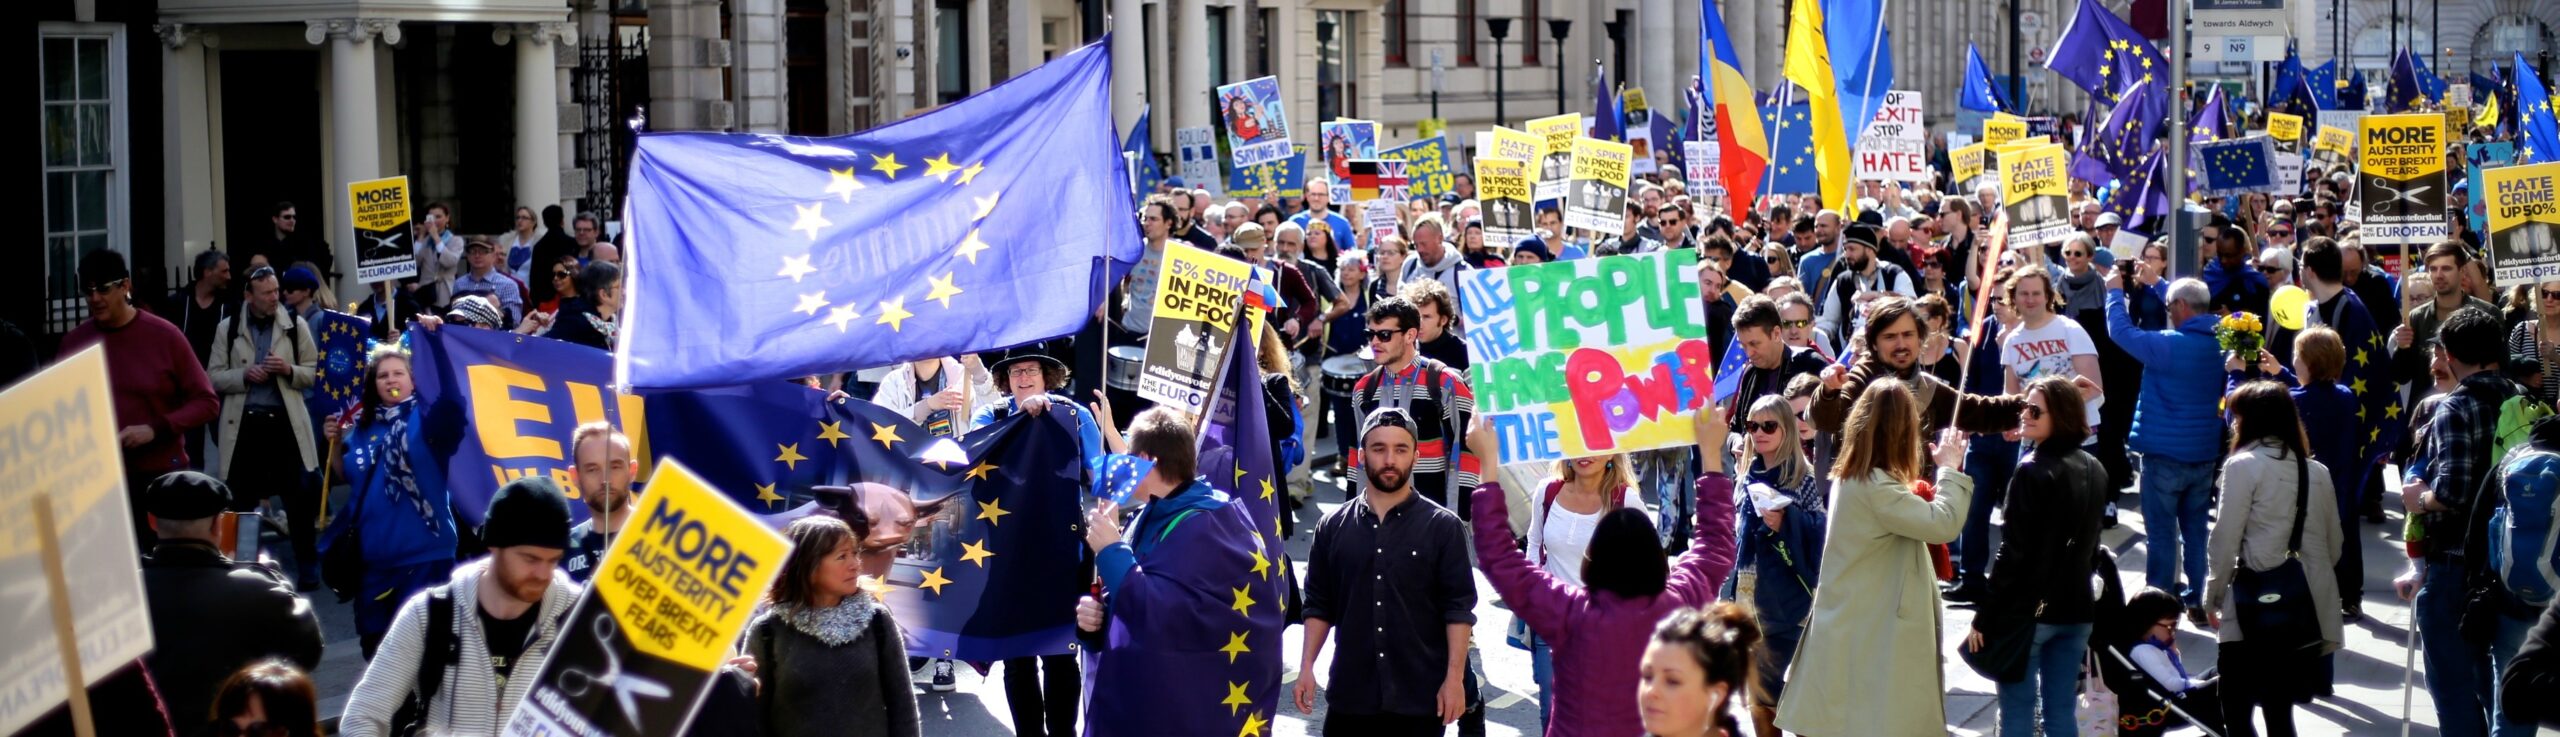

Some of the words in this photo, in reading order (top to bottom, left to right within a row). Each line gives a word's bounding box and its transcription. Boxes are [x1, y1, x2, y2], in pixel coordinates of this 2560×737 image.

[2239, 20, 2273, 28] Aldwych
[2204, 44, 2210, 52] 9
[2230, 44, 2245, 52] N9
[1886, 93, 1904, 105] OP
[1874, 107, 1922, 123] EXIT
[1549, 123, 1576, 132] SPIKE
[1874, 125, 1903, 137] STOP
[1989, 126, 2020, 136] MORE
[1546, 131, 1576, 142] PRICE
[2368, 126, 2435, 144] MORE
[1501, 139, 1535, 154] HATE
[1550, 140, 1573, 150] FOO
[2368, 145, 2436, 156] AUSTERITY
[1500, 148, 1532, 163] CRIME
[1596, 149, 1625, 161] SPIKE
[1862, 152, 1922, 172] HATE
[2368, 158, 2397, 166] OVER
[2399, 157, 2437, 165] BREXIT
[1577, 156, 1588, 165] IN
[1592, 159, 1624, 171] PRICE
[2011, 157, 2053, 173] HATE
[1496, 167, 1523, 177] SPIKE
[1576, 165, 1590, 174] OF
[1593, 169, 1624, 181] FOOD
[2012, 168, 2055, 183] CRIME
[2386, 167, 2419, 175] FEARS
[1428, 173, 1455, 195] EU
[1482, 176, 1492, 185] IN
[1494, 177, 1524, 186] PRICE
[2498, 176, 2552, 193] HATE
[356, 187, 402, 204] MORE
[1331, 187, 1351, 201] SAY
[1482, 186, 1494, 194] OF
[1501, 186, 1526, 196] FOOD
[2500, 189, 2554, 206] CRIME
[357, 201, 403, 213] AUSTERITY
[2501, 207, 2521, 218] UP
[2524, 203, 2556, 216] 50%
[358, 214, 378, 222] OVER
[379, 210, 404, 220] BREXIT
[2366, 214, 2442, 223] #didyouvoteforthat
[371, 220, 394, 228] FEARS
[2020, 226, 2071, 242] EUROPEAN
[2376, 226, 2446, 238] EUROPEAN
[368, 263, 416, 277] EUROPEAN
[1172, 258, 1199, 279] 5%
[1204, 269, 1248, 292] SPIK
[2510, 266, 2560, 279] EUROPE
[1168, 276, 1190, 296] IN
[1164, 294, 1192, 312] OF
[1507, 250, 1706, 350] PEOPLE
[1466, 318, 1520, 362] THE
[1142, 385, 1157, 393] NEW
[1144, 378, 1157, 386] THE
[1472, 352, 1572, 412] HAVE
[1484, 412, 1561, 464] THE
[642, 496, 758, 600] MORE
[626, 538, 735, 622] AUSTERITY
[613, 563, 655, 603] OVER
[656, 592, 720, 648] BREXIT
[624, 603, 678, 651] FEARS
